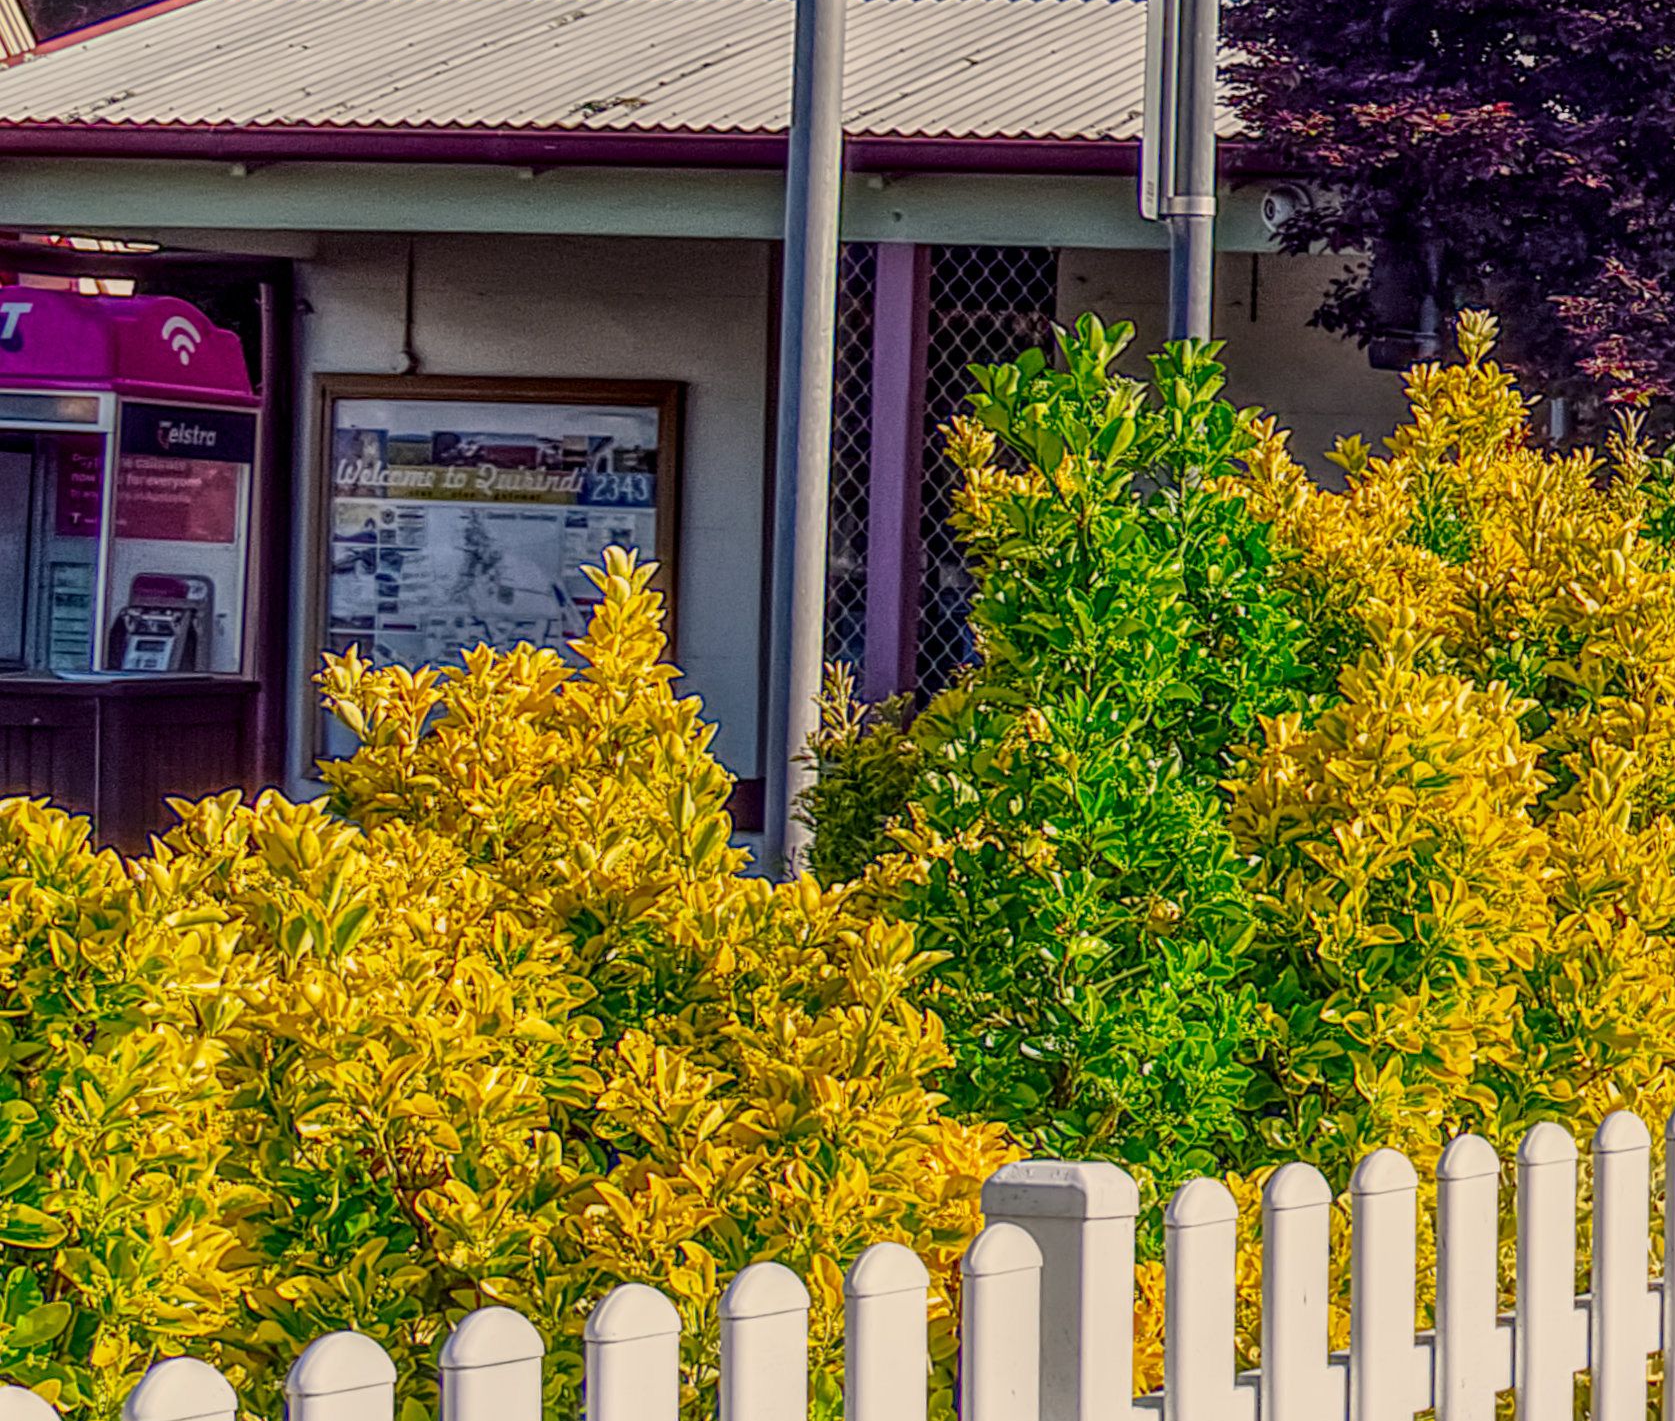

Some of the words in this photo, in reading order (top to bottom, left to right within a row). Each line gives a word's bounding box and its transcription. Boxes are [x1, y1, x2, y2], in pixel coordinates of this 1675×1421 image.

[159, 421, 217, 449] Telstra
[337, 459, 434, 488] Welcome
[444, 466, 467, 488] to
[476, 463, 584, 495] Quirindi
[593, 474, 647, 501] 2343
